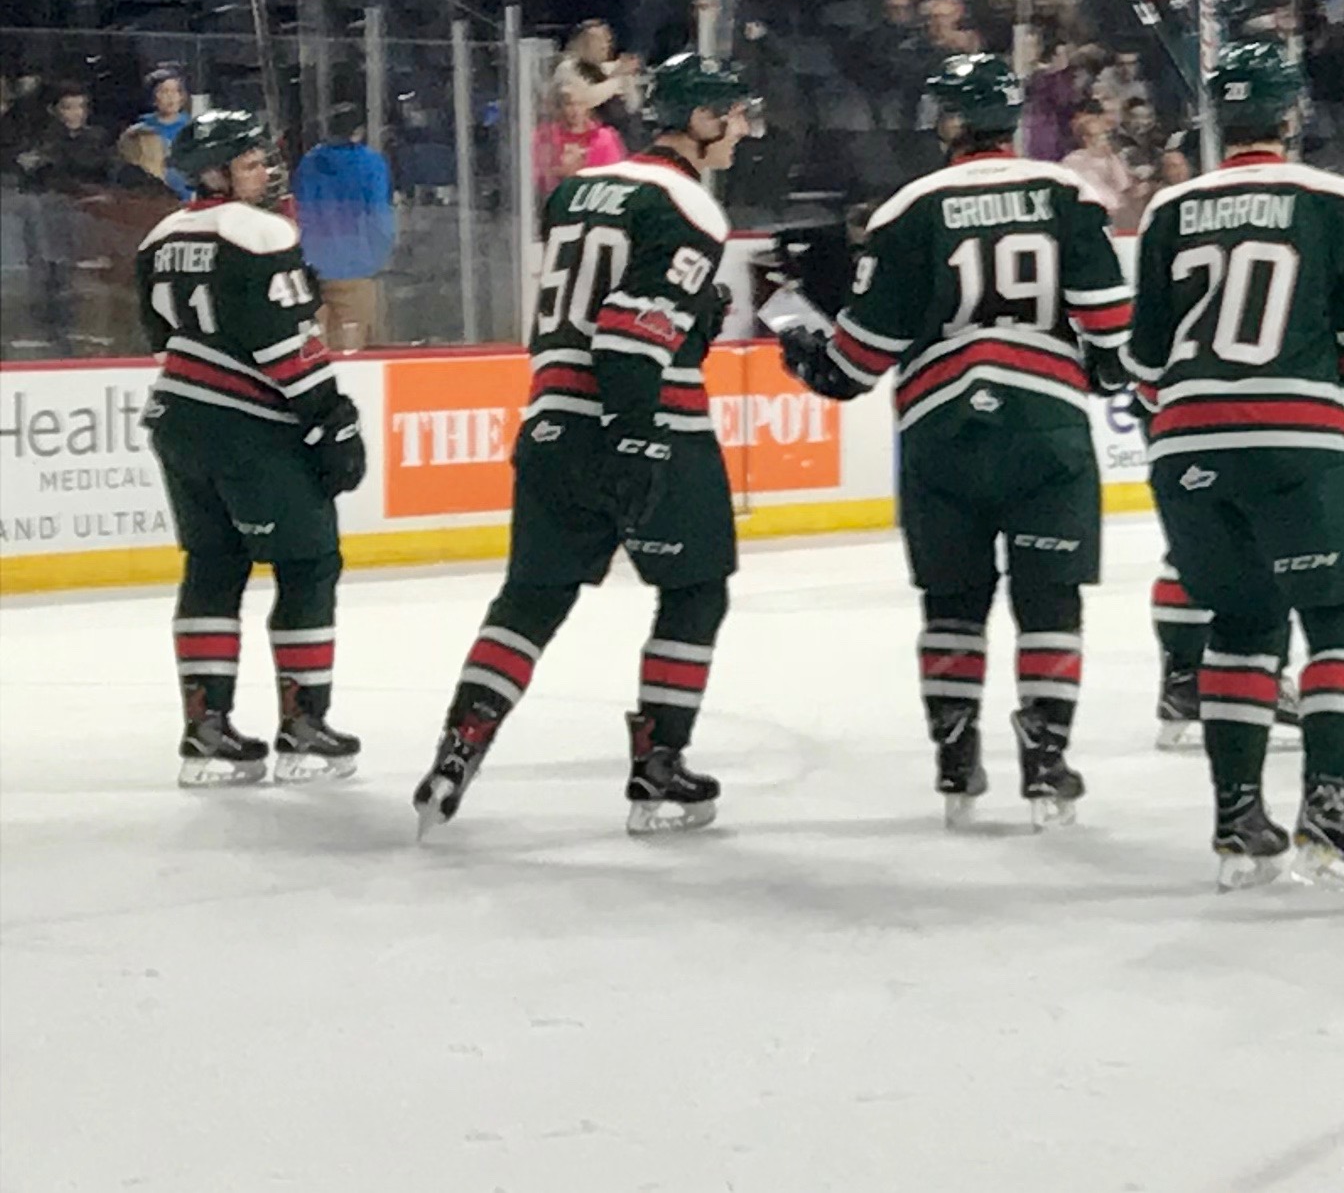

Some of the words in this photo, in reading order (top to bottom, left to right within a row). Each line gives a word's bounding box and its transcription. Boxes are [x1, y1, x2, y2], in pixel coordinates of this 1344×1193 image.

[942, 189, 1054, 229] GROULX
[1179, 194, 1296, 236] BARRON
[539, 223, 630, 337] 50
[942, 233, 1060, 337] 19
[1171, 241, 1300, 365] 20
[0, 385, 150, 457] Healt
[393, 408, 508, 467] THE
[712, 391, 834, 448] EPOT
[39, 468, 153, 493] MEDICAL
[1014, 533, 1081, 552] CCM
[1274, 551, 1340, 573] CCM
